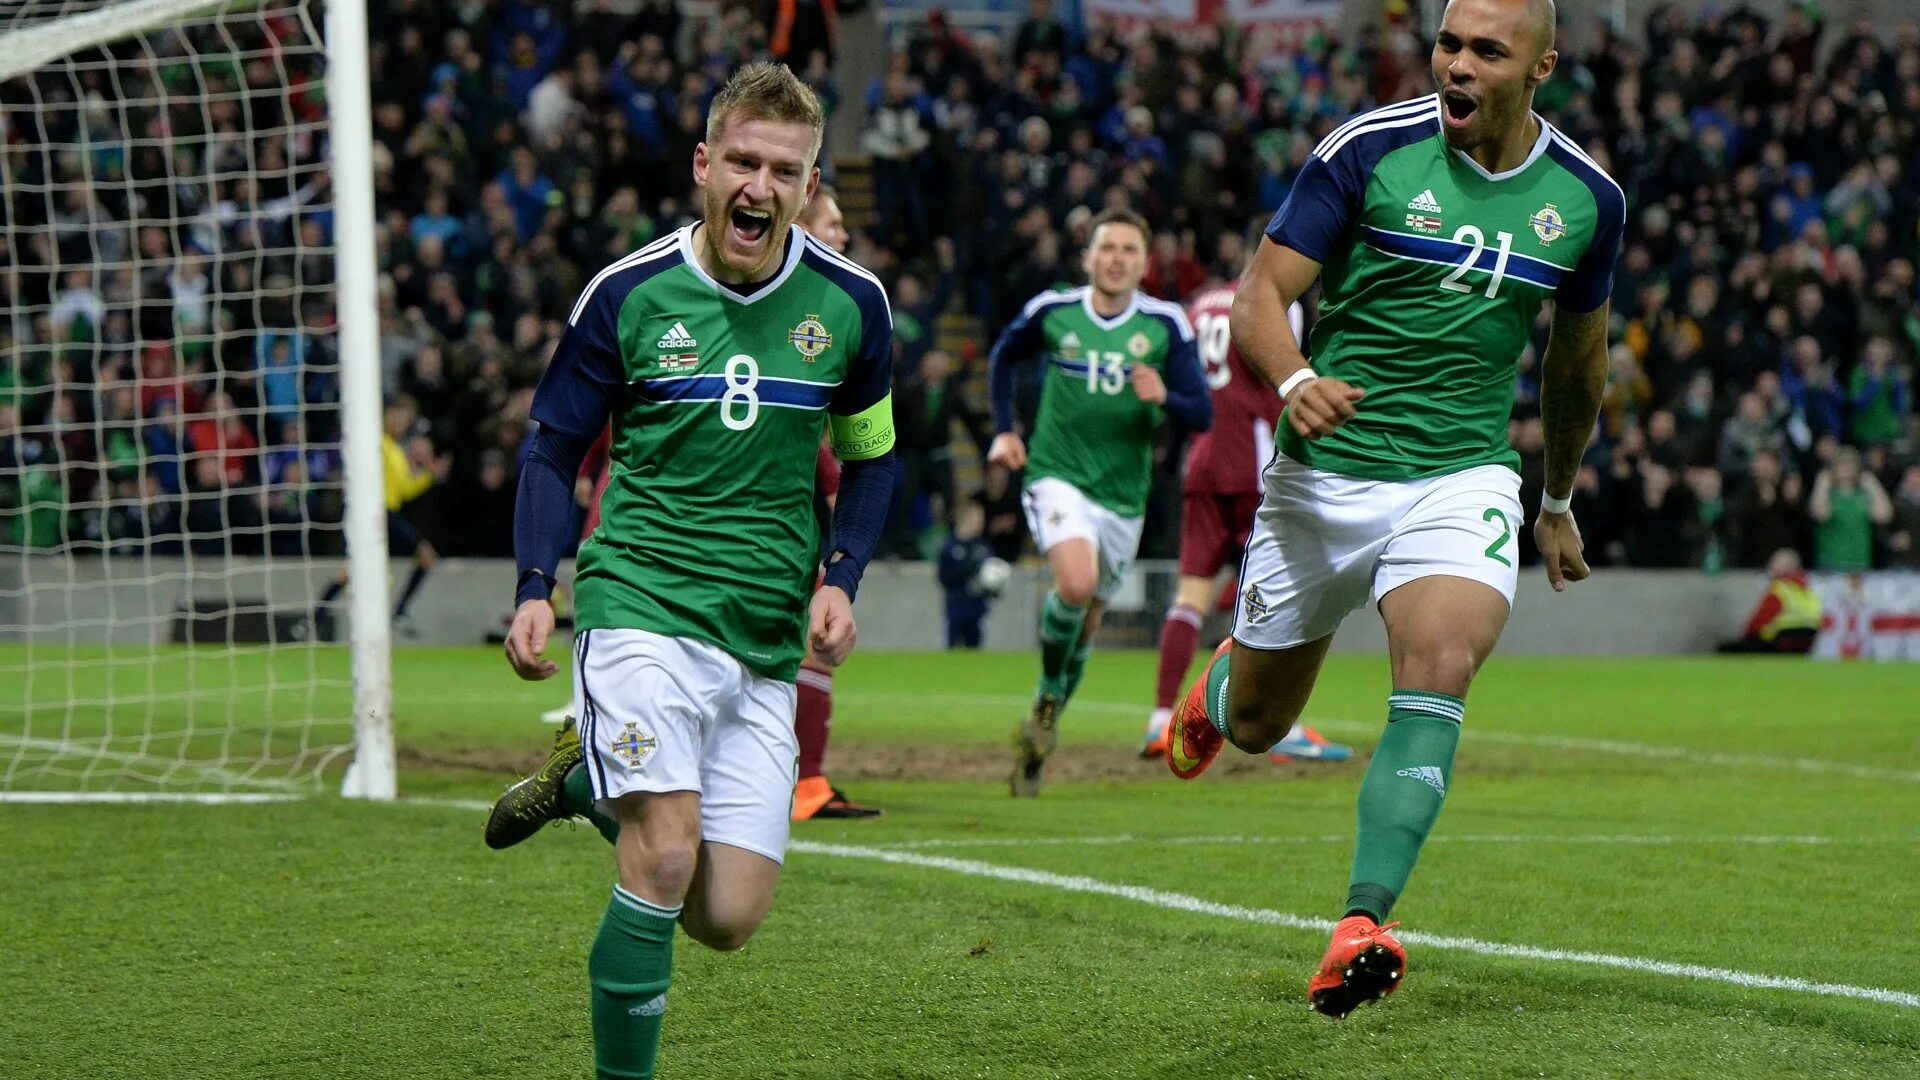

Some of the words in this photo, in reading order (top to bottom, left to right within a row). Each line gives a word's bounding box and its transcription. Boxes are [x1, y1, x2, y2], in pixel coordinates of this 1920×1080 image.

[1407, 201, 1442, 213] adidas
[1439, 224, 1513, 299] 21
[657, 338, 697, 348] adidas
[1196, 312, 1231, 390] 19
[720, 354, 759, 431] 8
[1087, 350, 1125, 395] 13
[848, 443, 862, 451] TO
[1483, 508, 1511, 568] 2
[628, 1006, 664, 1016] adid
